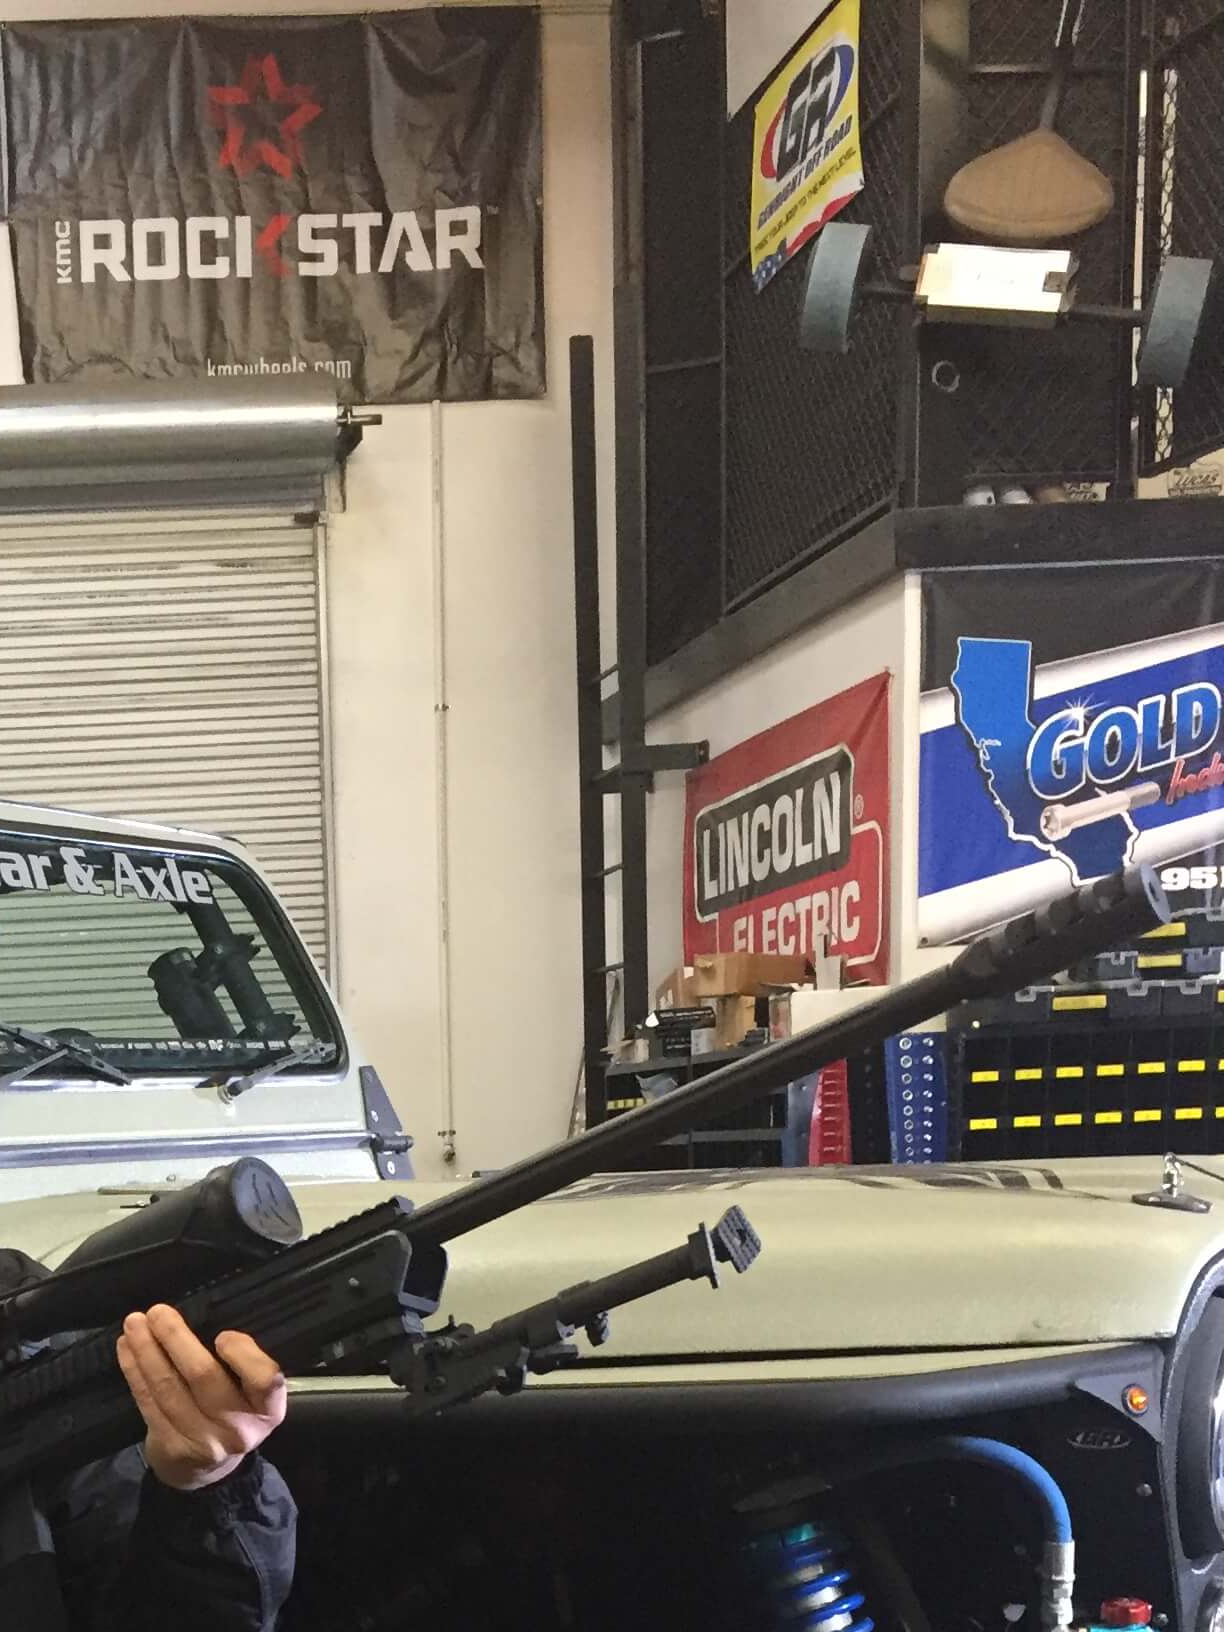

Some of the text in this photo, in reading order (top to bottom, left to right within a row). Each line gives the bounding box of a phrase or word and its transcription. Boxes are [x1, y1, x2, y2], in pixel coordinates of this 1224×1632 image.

[1027, 680, 1224, 801] GOLD
[65, 845, 106, 898] &
[112, 851, 215, 905] Axle
[701, 770, 843, 901] LINCOLN
[1160, 865, 1224, 892] 95
